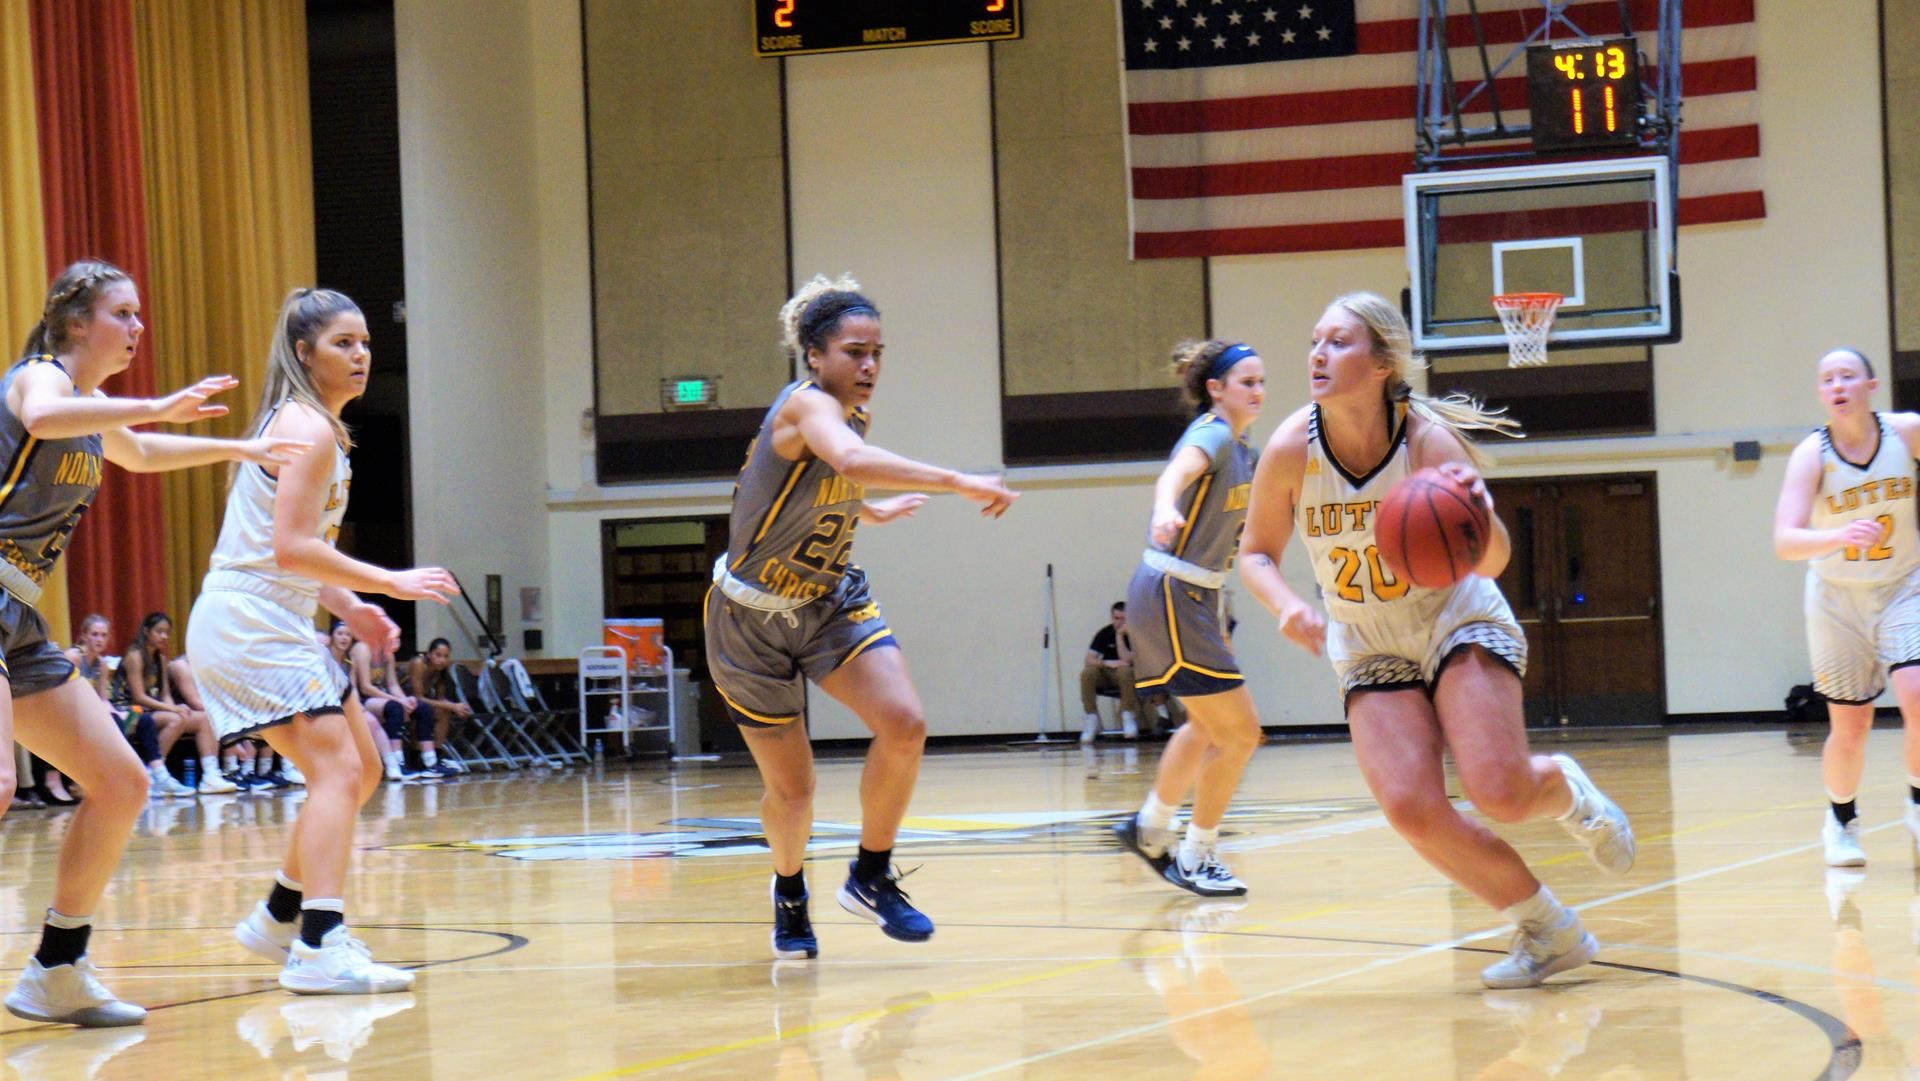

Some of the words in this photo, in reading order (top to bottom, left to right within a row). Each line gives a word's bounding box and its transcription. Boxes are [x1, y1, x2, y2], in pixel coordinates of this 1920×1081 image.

[761, 35, 803, 50] SCORE
[863, 27, 906, 43] MATCH
[970, 19, 1013, 35] SCORE
[1554, 47, 1626, 80] 4:13
[1572, 85, 1616, 134] 11
[1306, 500, 1381, 537] LUT
[1328, 544, 1411, 603] 20
